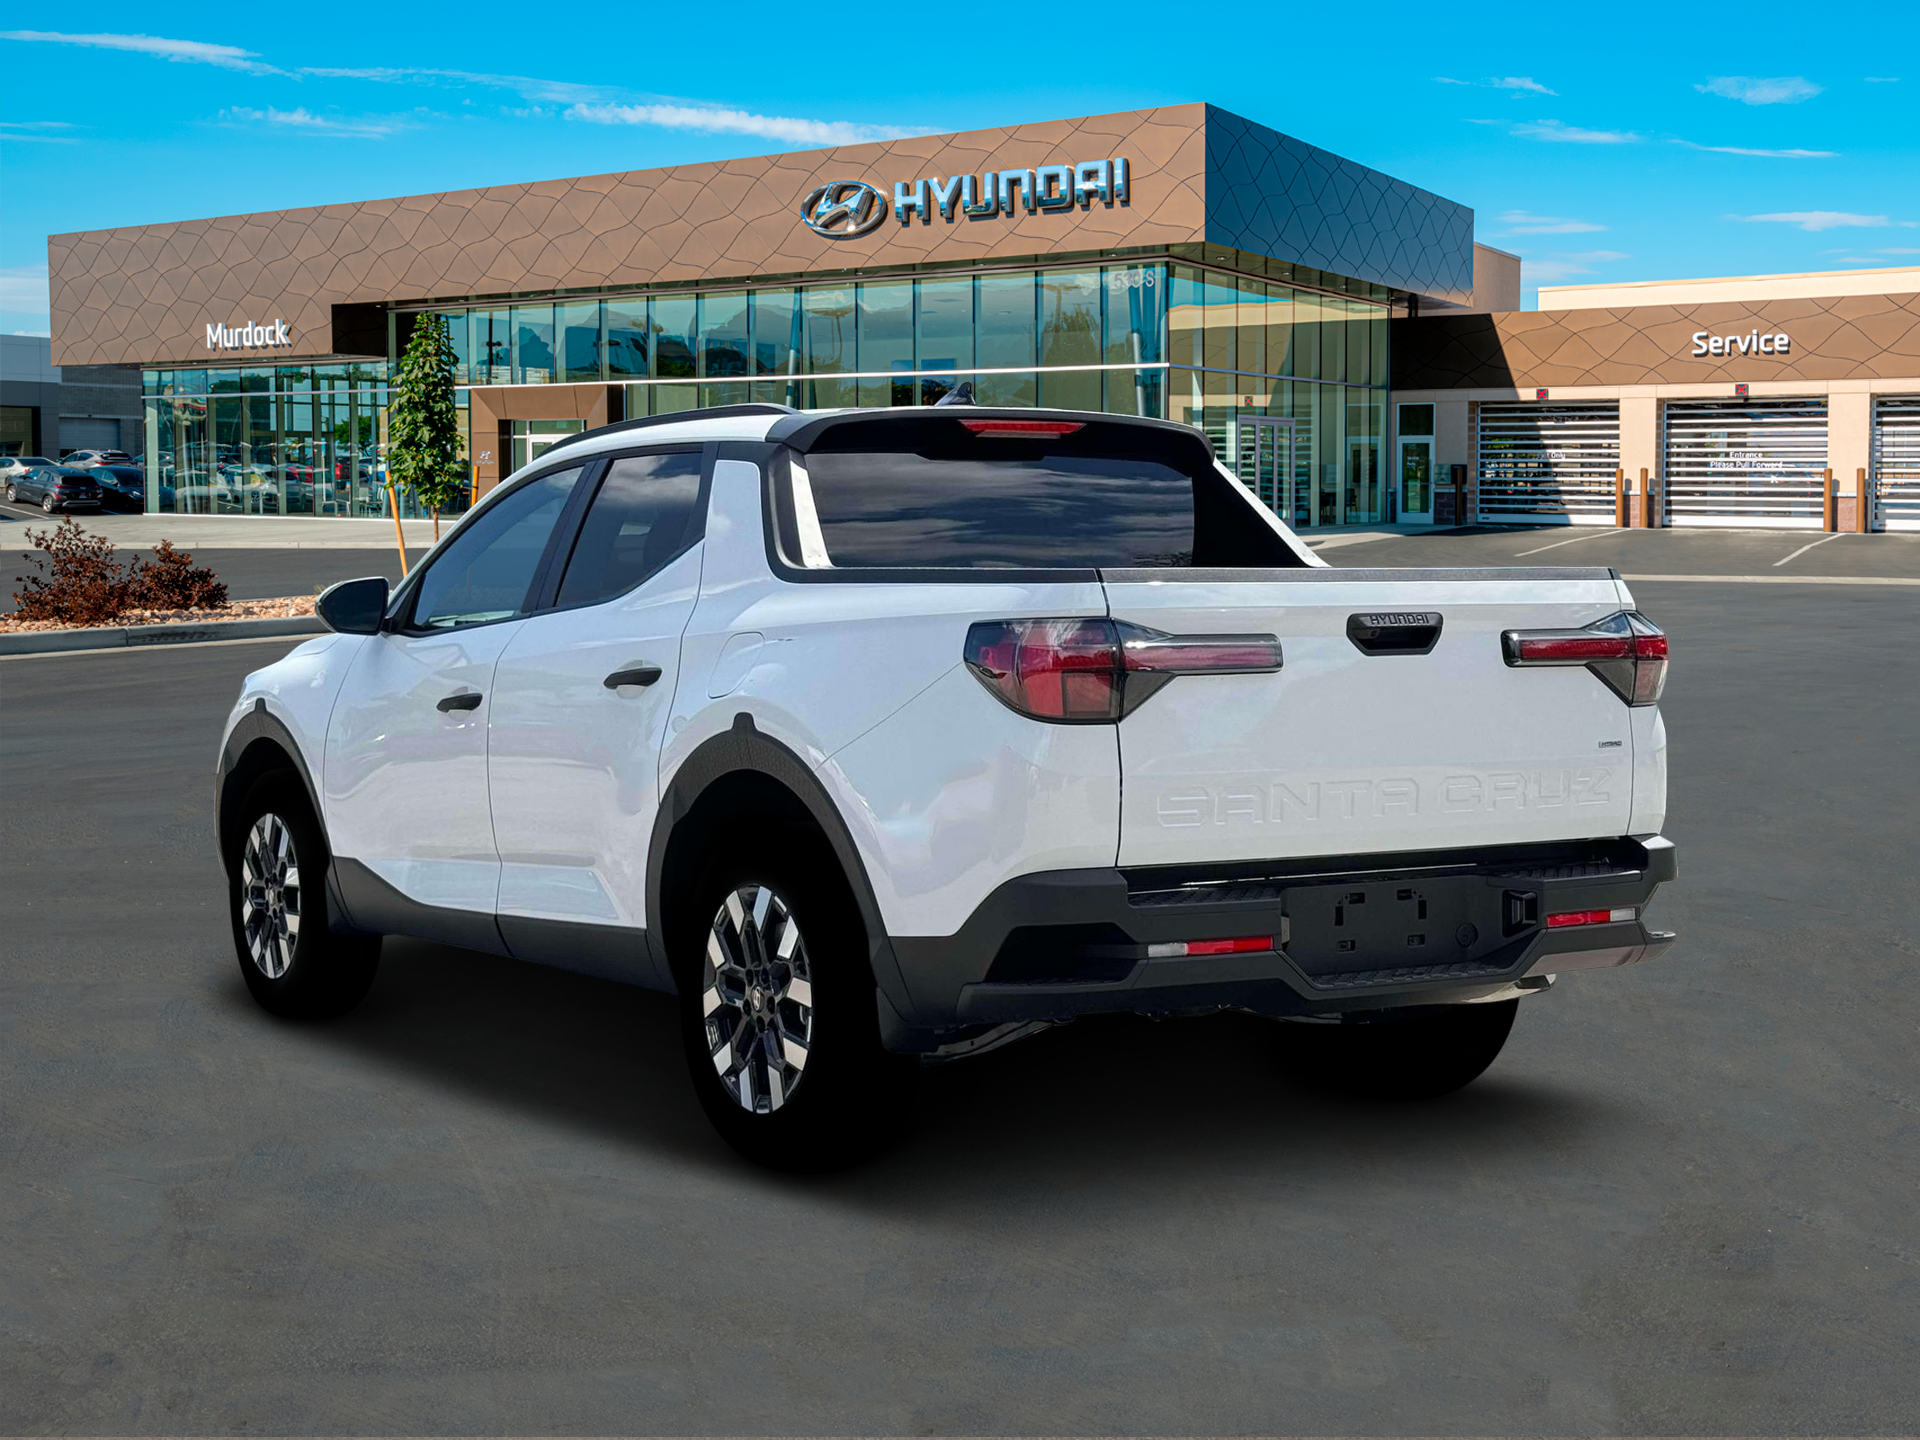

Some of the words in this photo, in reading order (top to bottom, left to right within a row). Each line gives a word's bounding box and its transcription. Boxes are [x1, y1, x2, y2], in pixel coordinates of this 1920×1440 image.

[894, 157, 1129, 223] HYUNDAI
[1114, 271, 1141, 289] 530
[1145, 270, 1155, 287] S
[206, 318, 291, 349] Murdock
[1691, 329, 1790, 356] Service
[1551, 452, 1566, 460] Only
[1729, 451, 1763, 459] Entrance
[1369, 614, 1430, 625] HYUNDAI
[1157, 777, 1420, 828] SANTA
[1438, 766, 1613, 814] CRUZ
